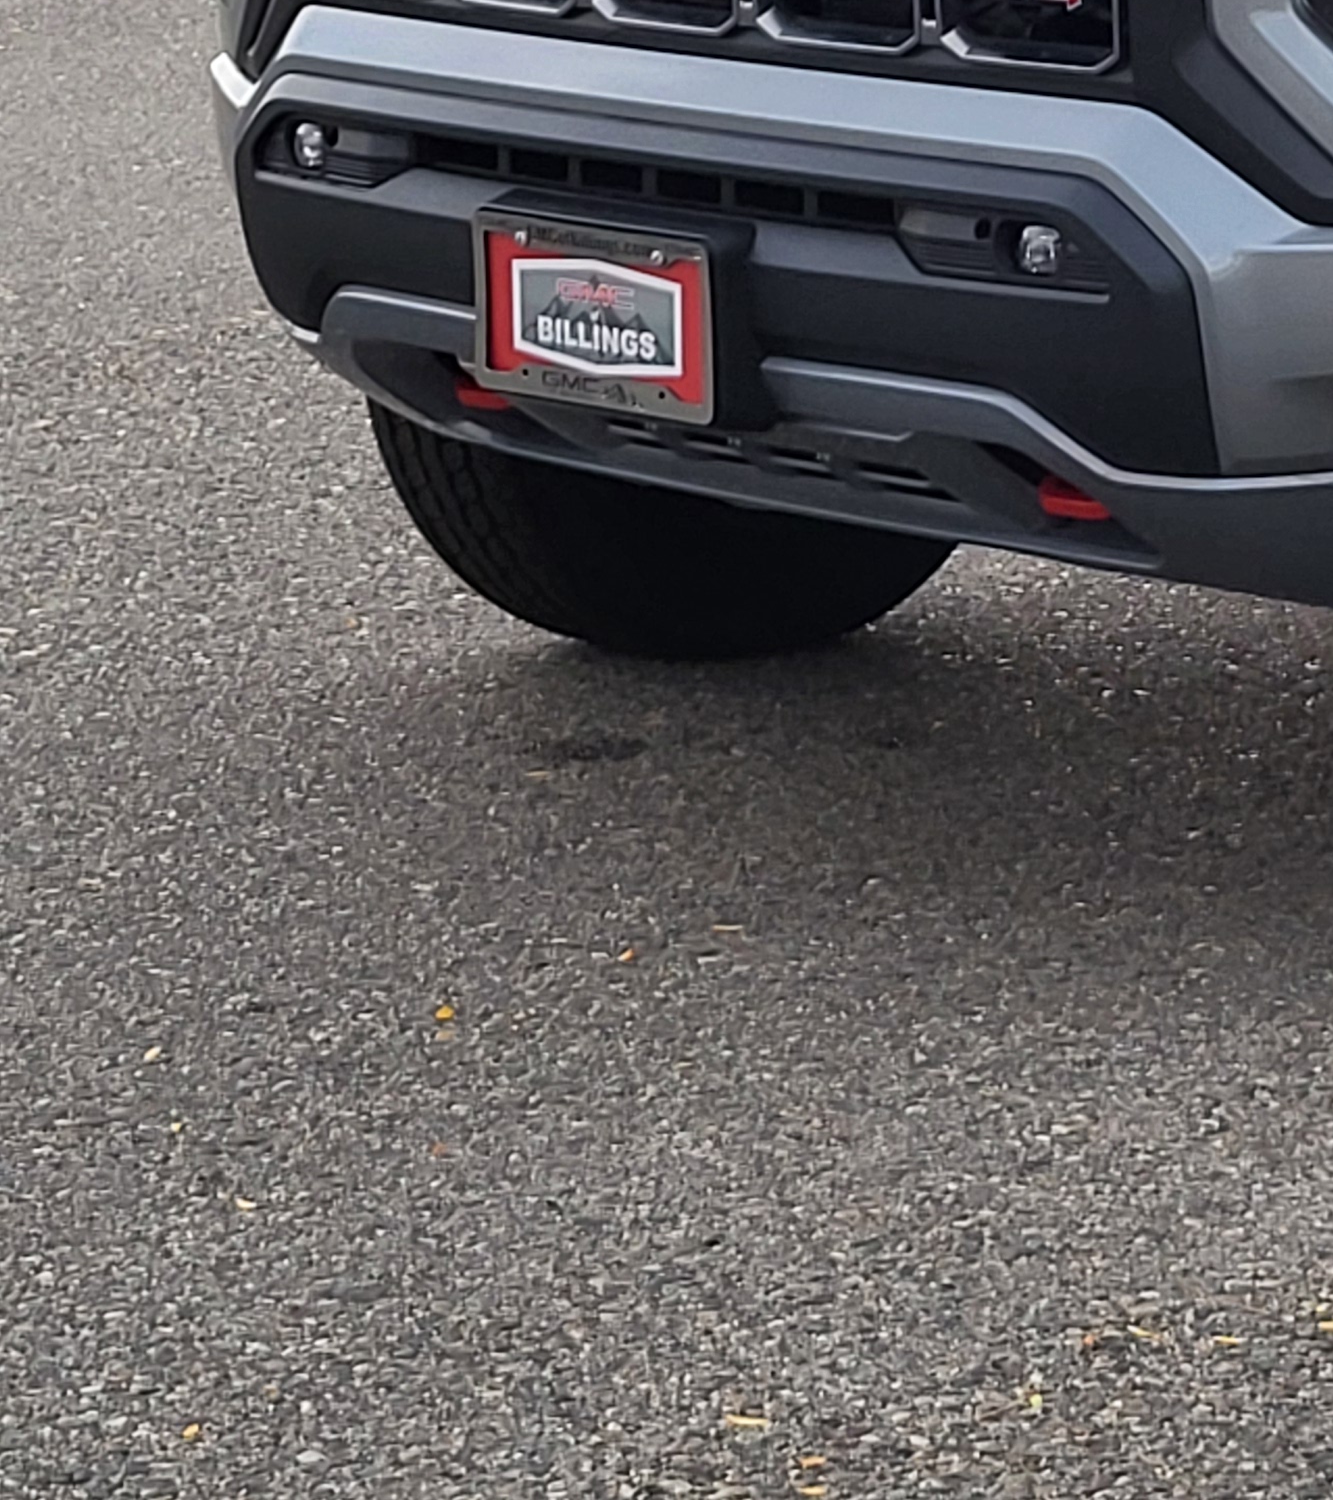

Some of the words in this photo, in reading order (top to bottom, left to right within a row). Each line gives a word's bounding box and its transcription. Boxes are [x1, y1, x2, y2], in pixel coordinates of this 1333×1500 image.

[556, 277, 635, 311] GMC
[538, 316, 656, 360] BILLINGS
[542, 371, 601, 393] GMC
